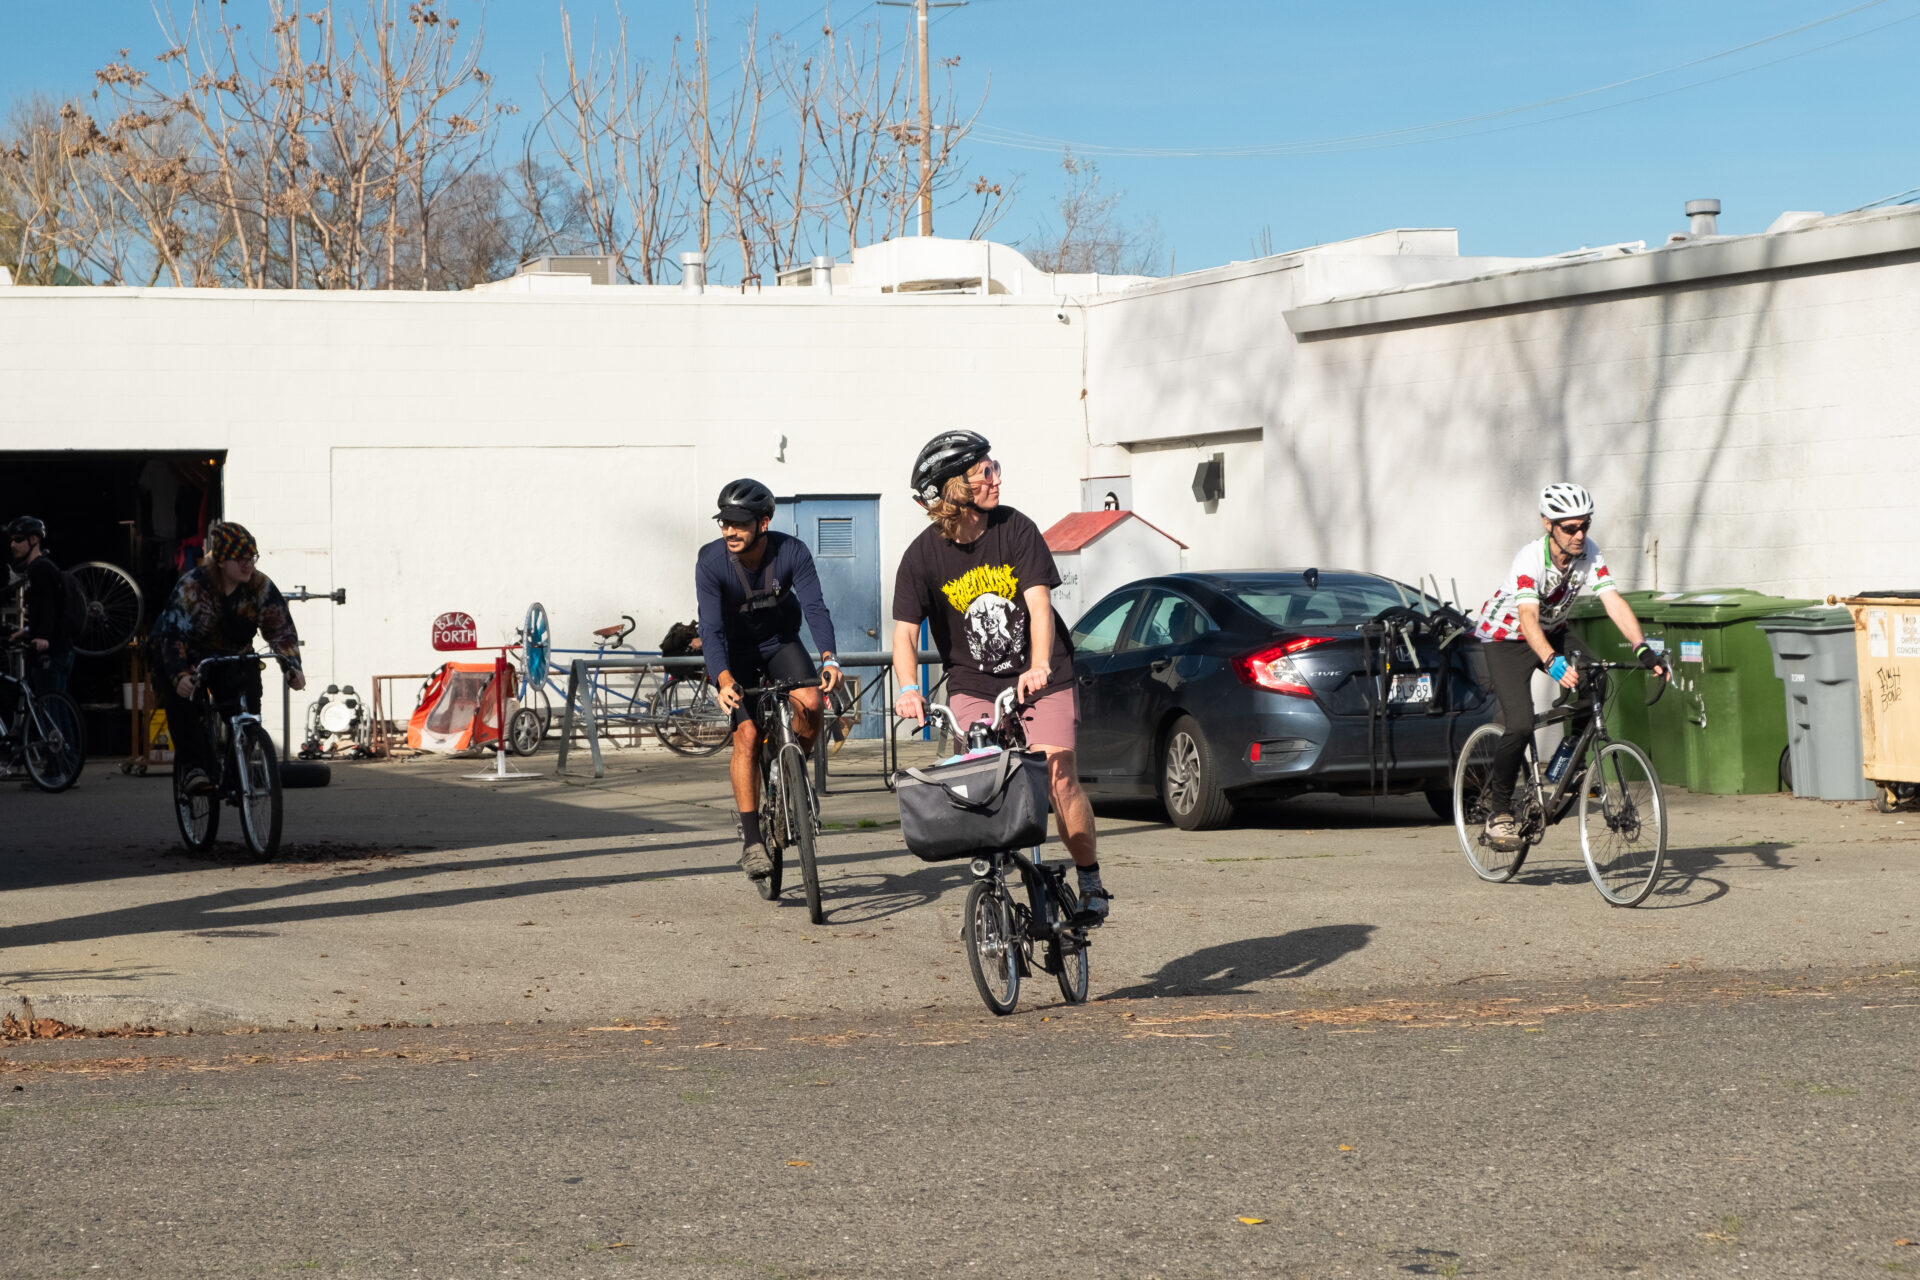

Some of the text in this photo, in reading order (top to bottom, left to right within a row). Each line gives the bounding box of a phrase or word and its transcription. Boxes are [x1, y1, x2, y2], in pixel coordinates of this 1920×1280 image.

[435, 613, 473, 630] BIKE
[434, 630, 476, 643] FORTH
[993, 661, 1013, 674] 200K
